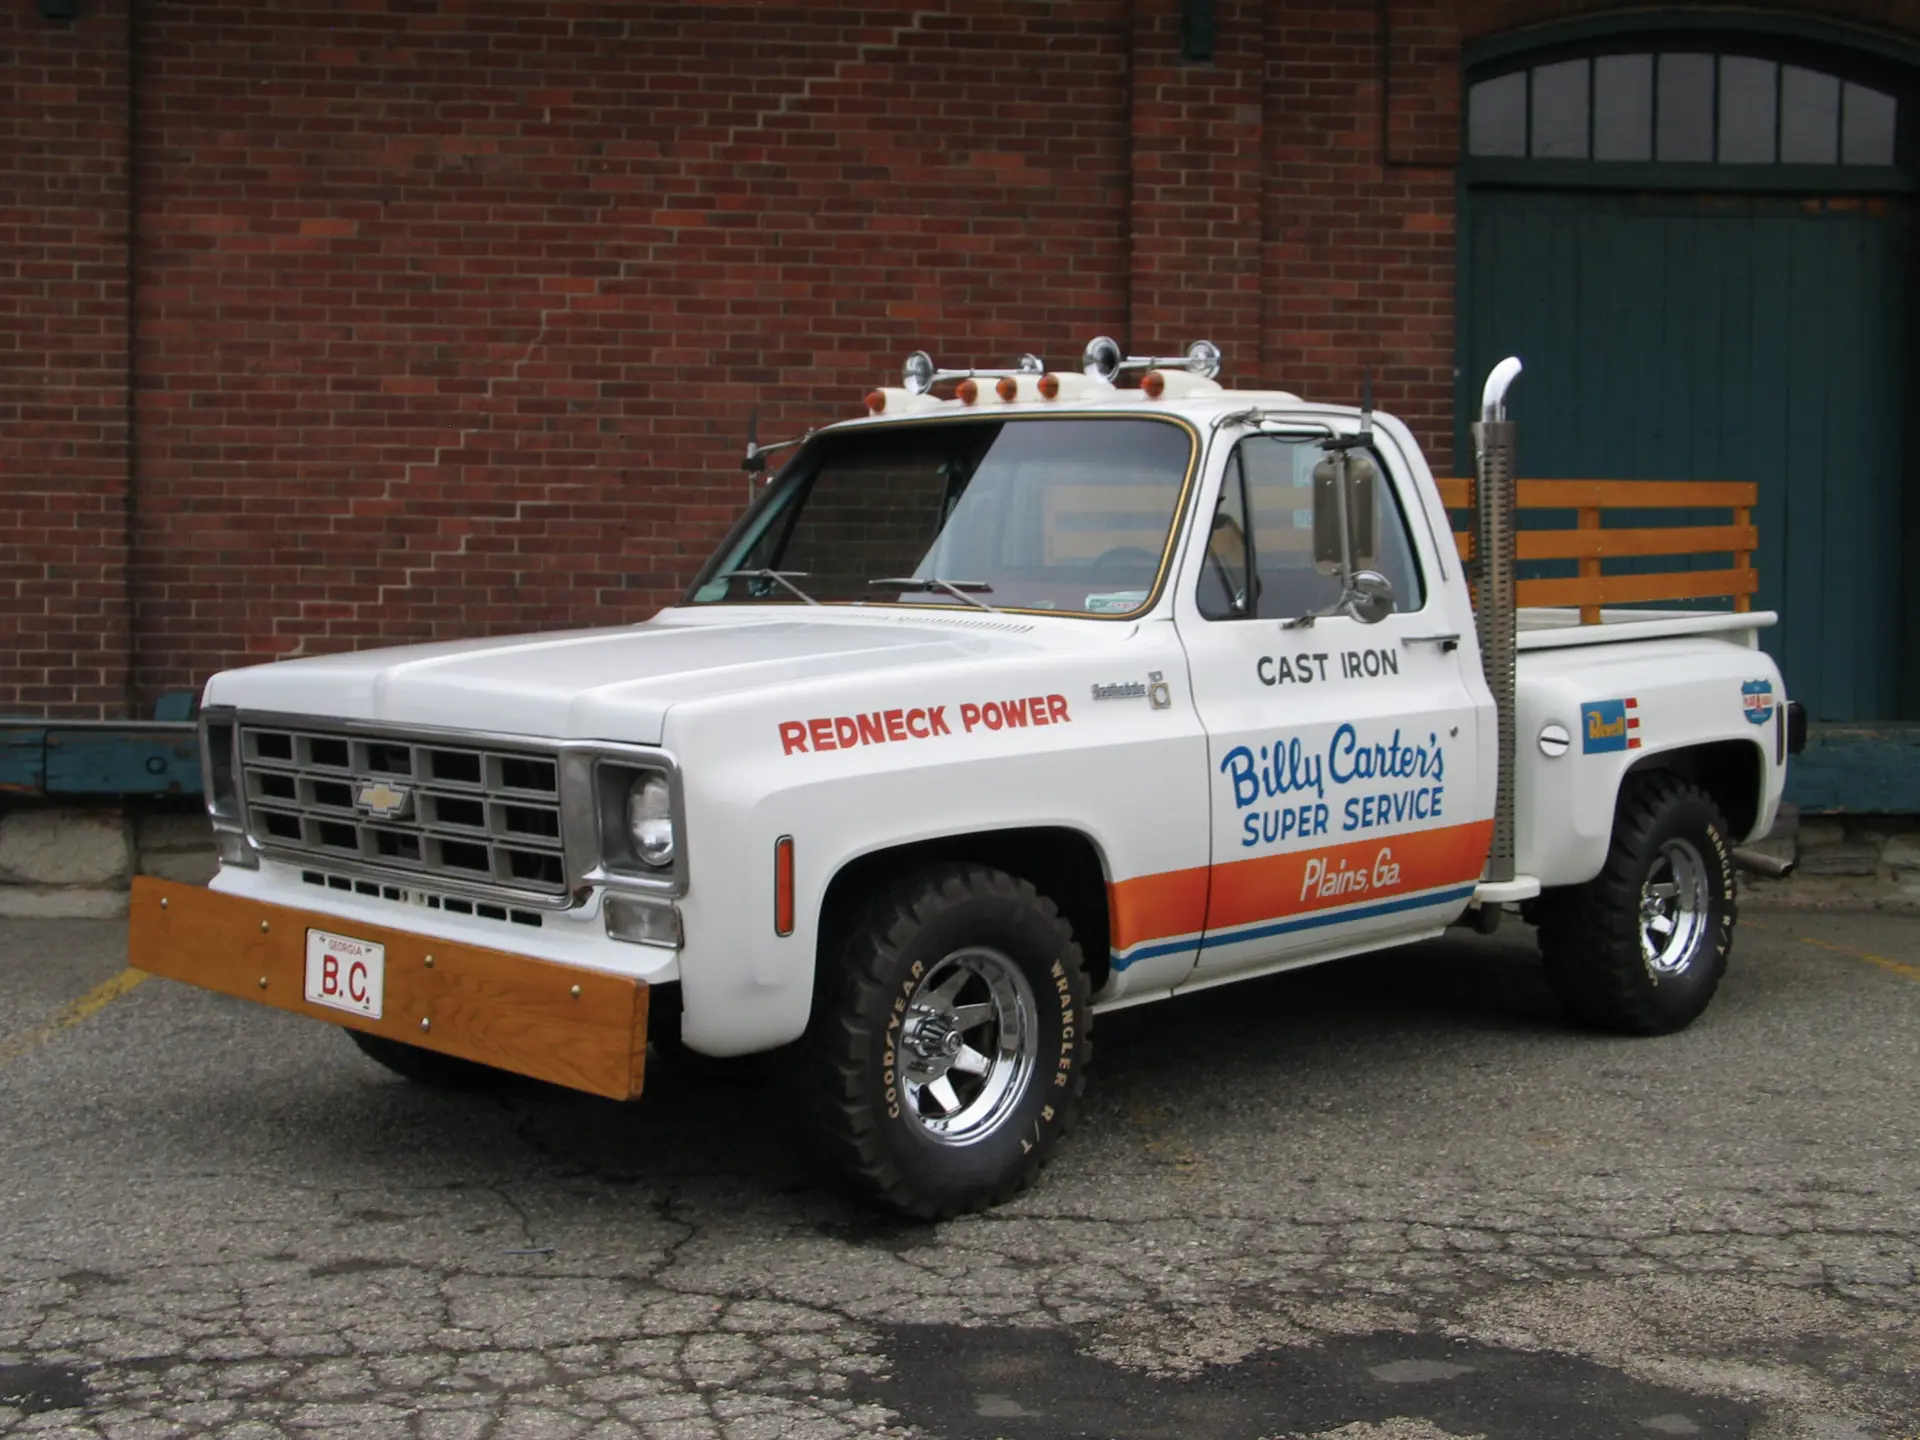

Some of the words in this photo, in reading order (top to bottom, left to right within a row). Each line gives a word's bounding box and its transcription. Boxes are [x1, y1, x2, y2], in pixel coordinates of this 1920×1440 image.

[1256, 652, 1329, 686] CAST
[1340, 649, 1399, 679] IRON
[777, 704, 952, 756] REDNECK
[959, 693, 1072, 733] POWER
[1220, 737, 1325, 809] Billy
[1328, 723, 1445, 785] Carter's
[1241, 802, 1330, 848] SUPER
[1342, 786, 1444, 832] SERVICE
[1300, 857, 1369, 902] Plains,
[1372, 847, 1402, 888] Ga.
[322, 953, 371, 1005] B.C.
[882, 959, 925, 1120] GOODYEAR
[1050, 957, 1076, 1088] WRANGLER
